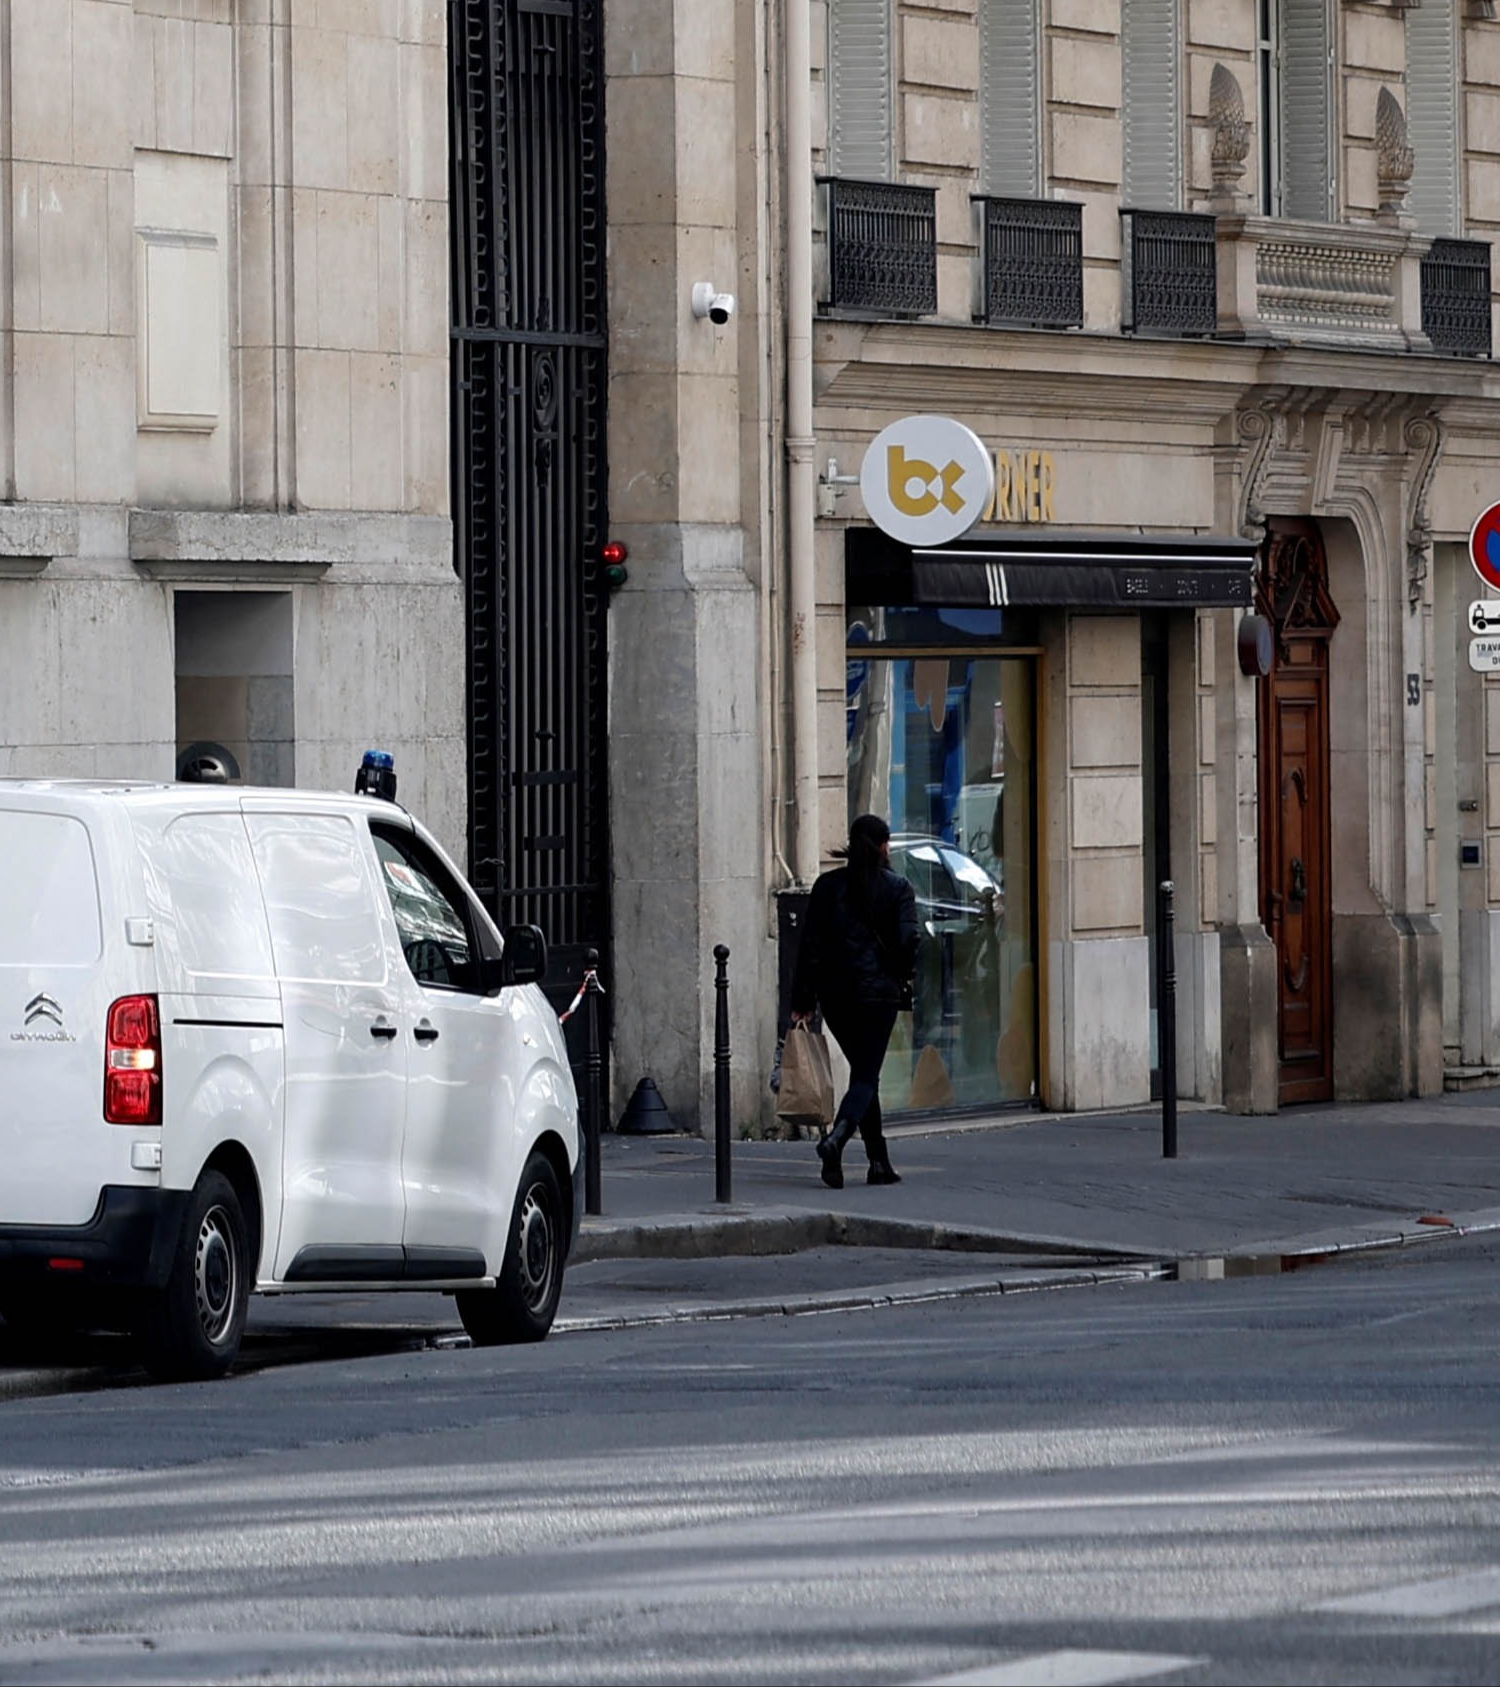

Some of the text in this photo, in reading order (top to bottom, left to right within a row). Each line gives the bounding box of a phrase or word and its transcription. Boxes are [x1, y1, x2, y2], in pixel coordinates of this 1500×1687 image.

[983, 450, 1056, 522] RNER
[1476, 643, 1500, 652] TRAV
[1407, 673, 1420, 707] 53
